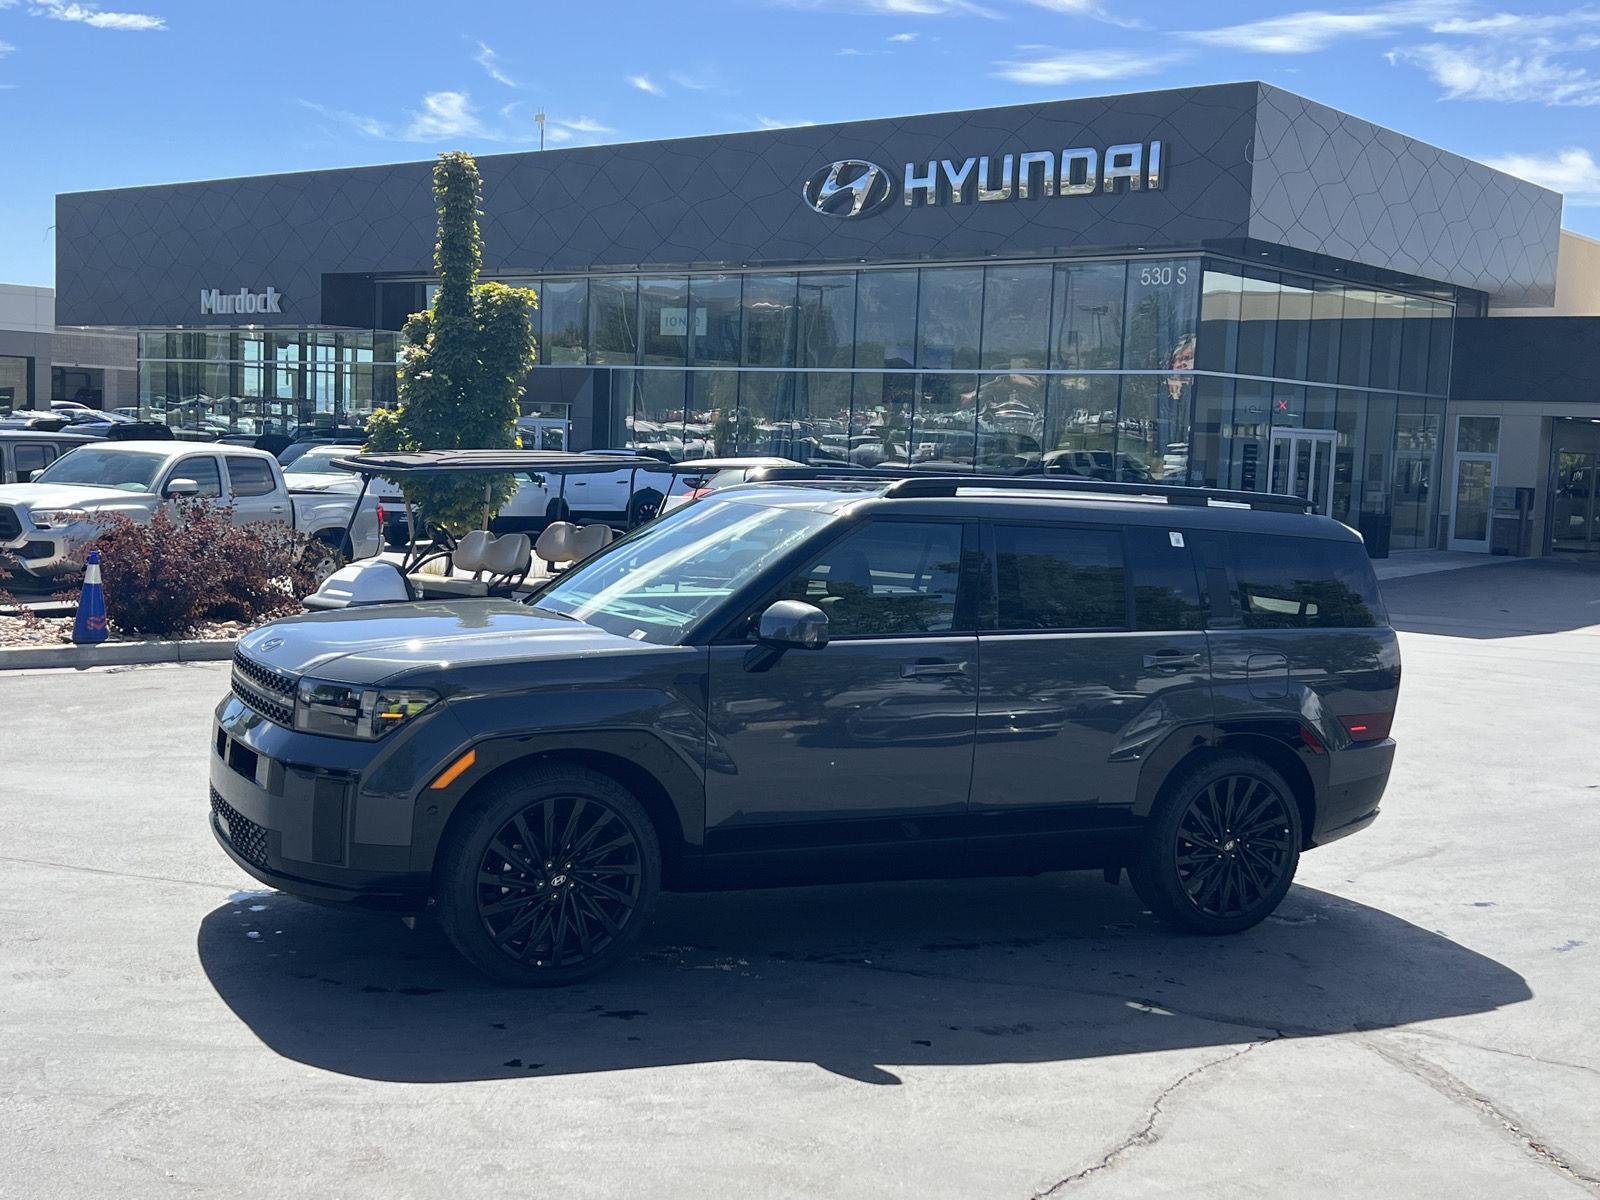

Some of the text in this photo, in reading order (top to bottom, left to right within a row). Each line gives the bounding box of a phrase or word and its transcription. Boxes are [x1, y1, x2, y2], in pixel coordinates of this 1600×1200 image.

[904, 140, 1162, 206] HYUNDAI
[1140, 266, 1187, 285] 530 S
[200, 286, 282, 315] Murdock
